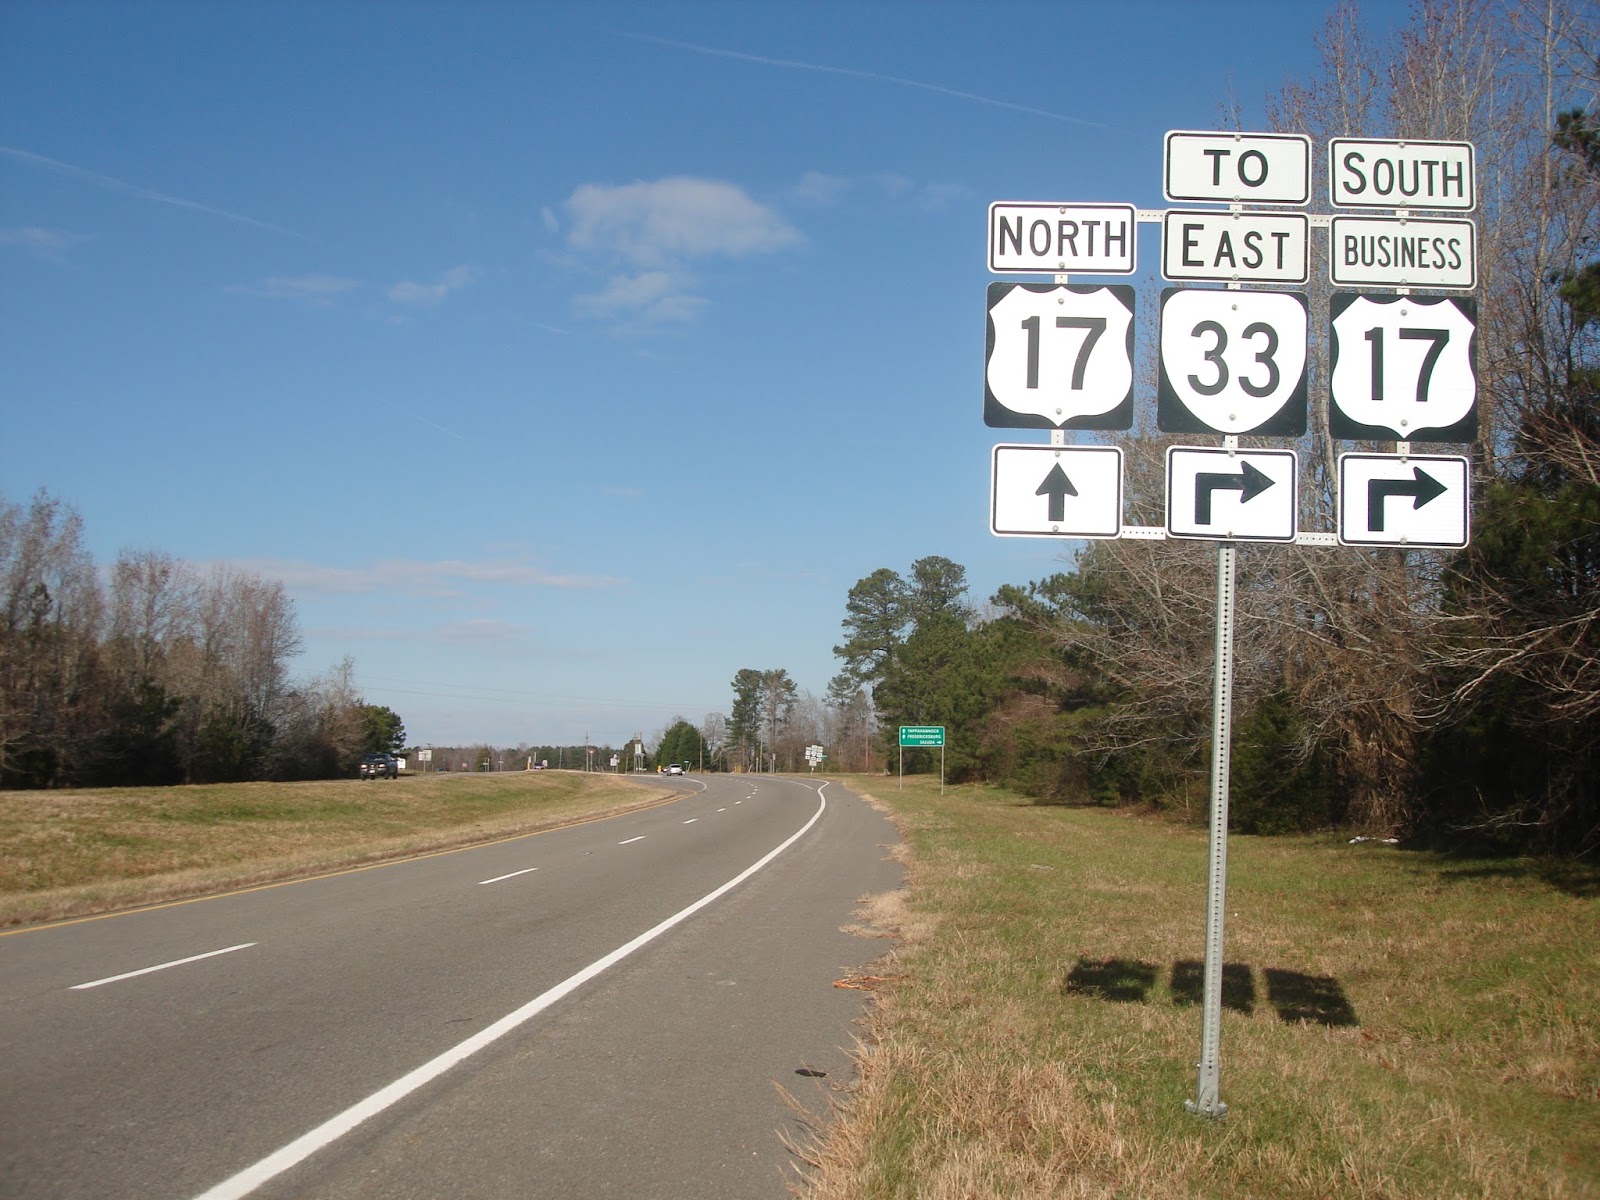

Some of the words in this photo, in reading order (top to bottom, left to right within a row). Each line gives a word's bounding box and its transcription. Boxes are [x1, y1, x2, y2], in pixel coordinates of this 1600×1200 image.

[1203, 149, 1269, 187] TO
[1343, 152, 1463, 198] SOUTH
[999, 216, 1127, 258] NORTH
[1182, 223, 1290, 270] EAST
[1344, 235, 1463, 270] BUSINESS
[1021, 315, 1107, 390] 17
[1187, 320, 1280, 398] 33
[1364, 327, 1450, 402] 17
